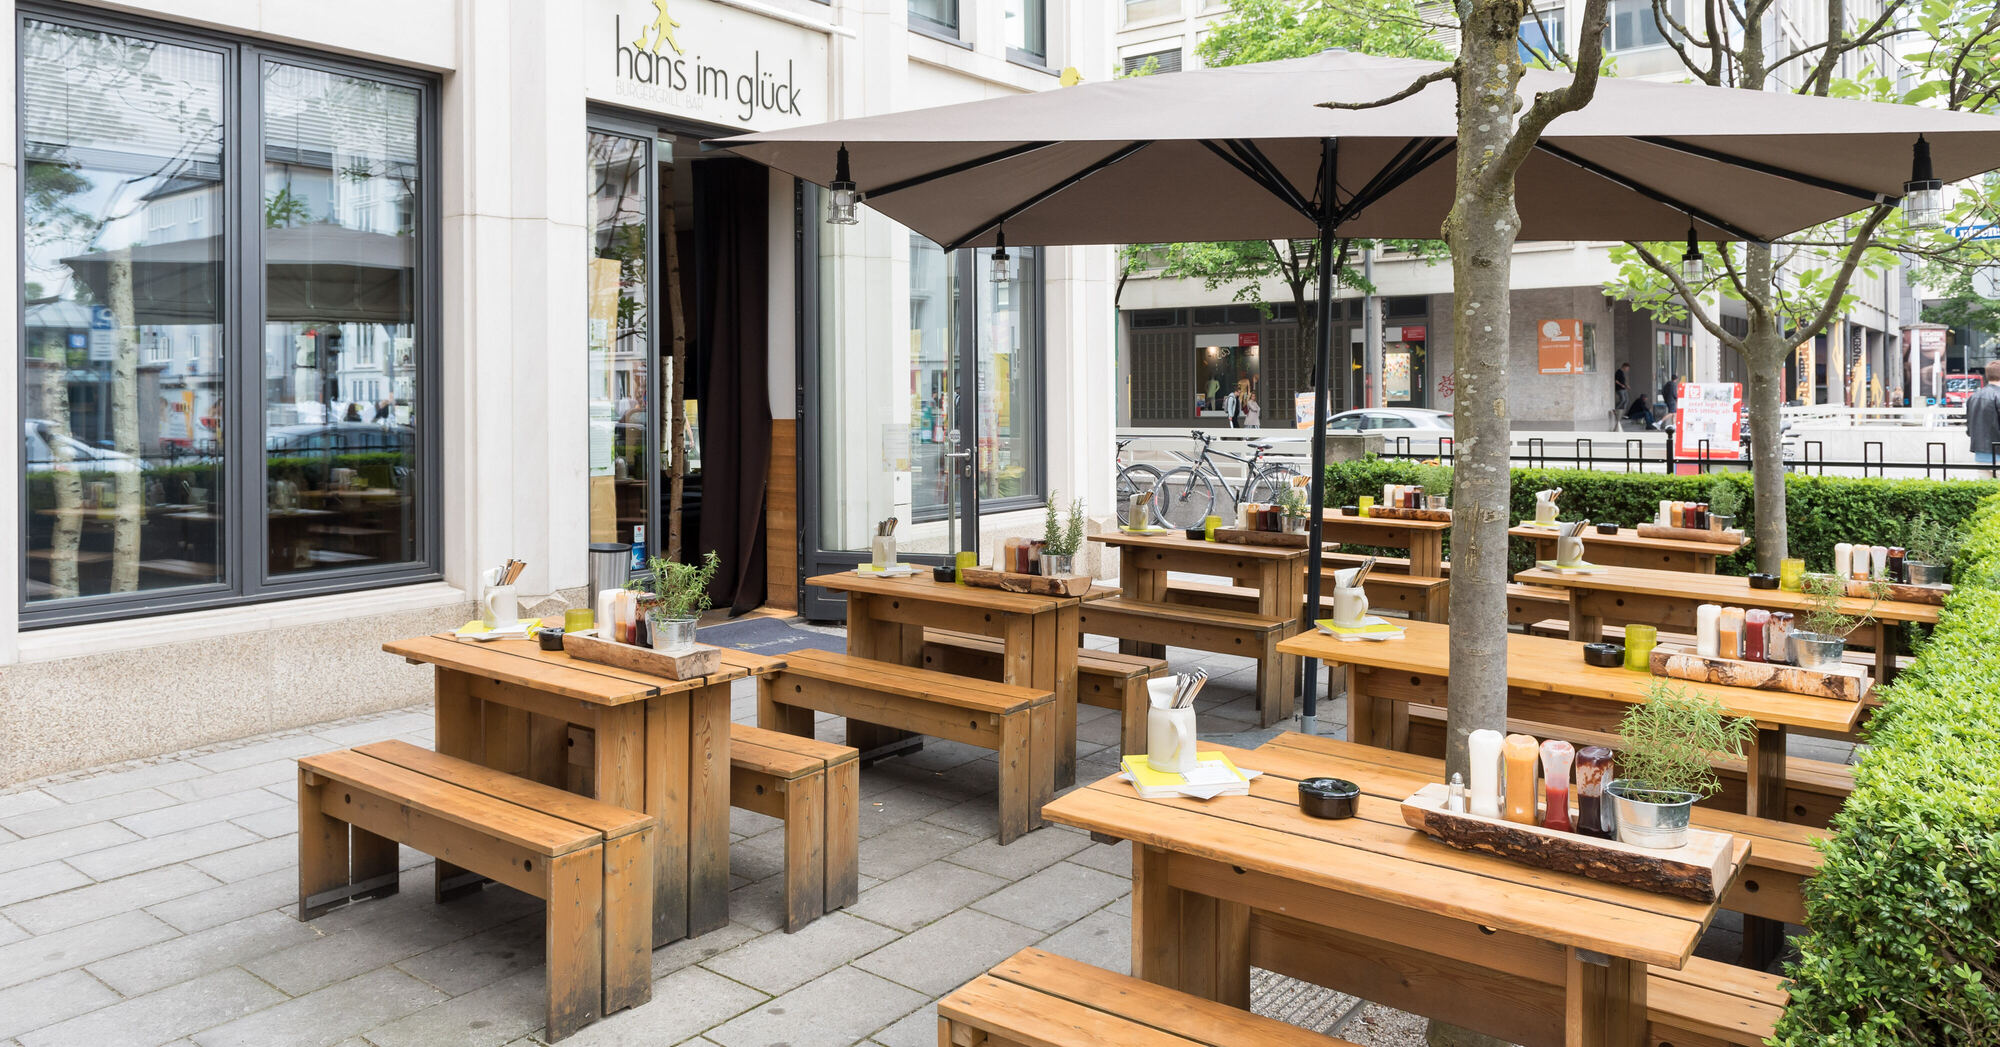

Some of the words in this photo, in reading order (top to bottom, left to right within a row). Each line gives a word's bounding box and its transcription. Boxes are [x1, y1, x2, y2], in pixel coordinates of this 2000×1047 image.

[616, 14, 687, 91] hans
[696, 56, 728, 100] im
[736, 50, 802, 121] glück
[685, 95, 704, 112] BAR
